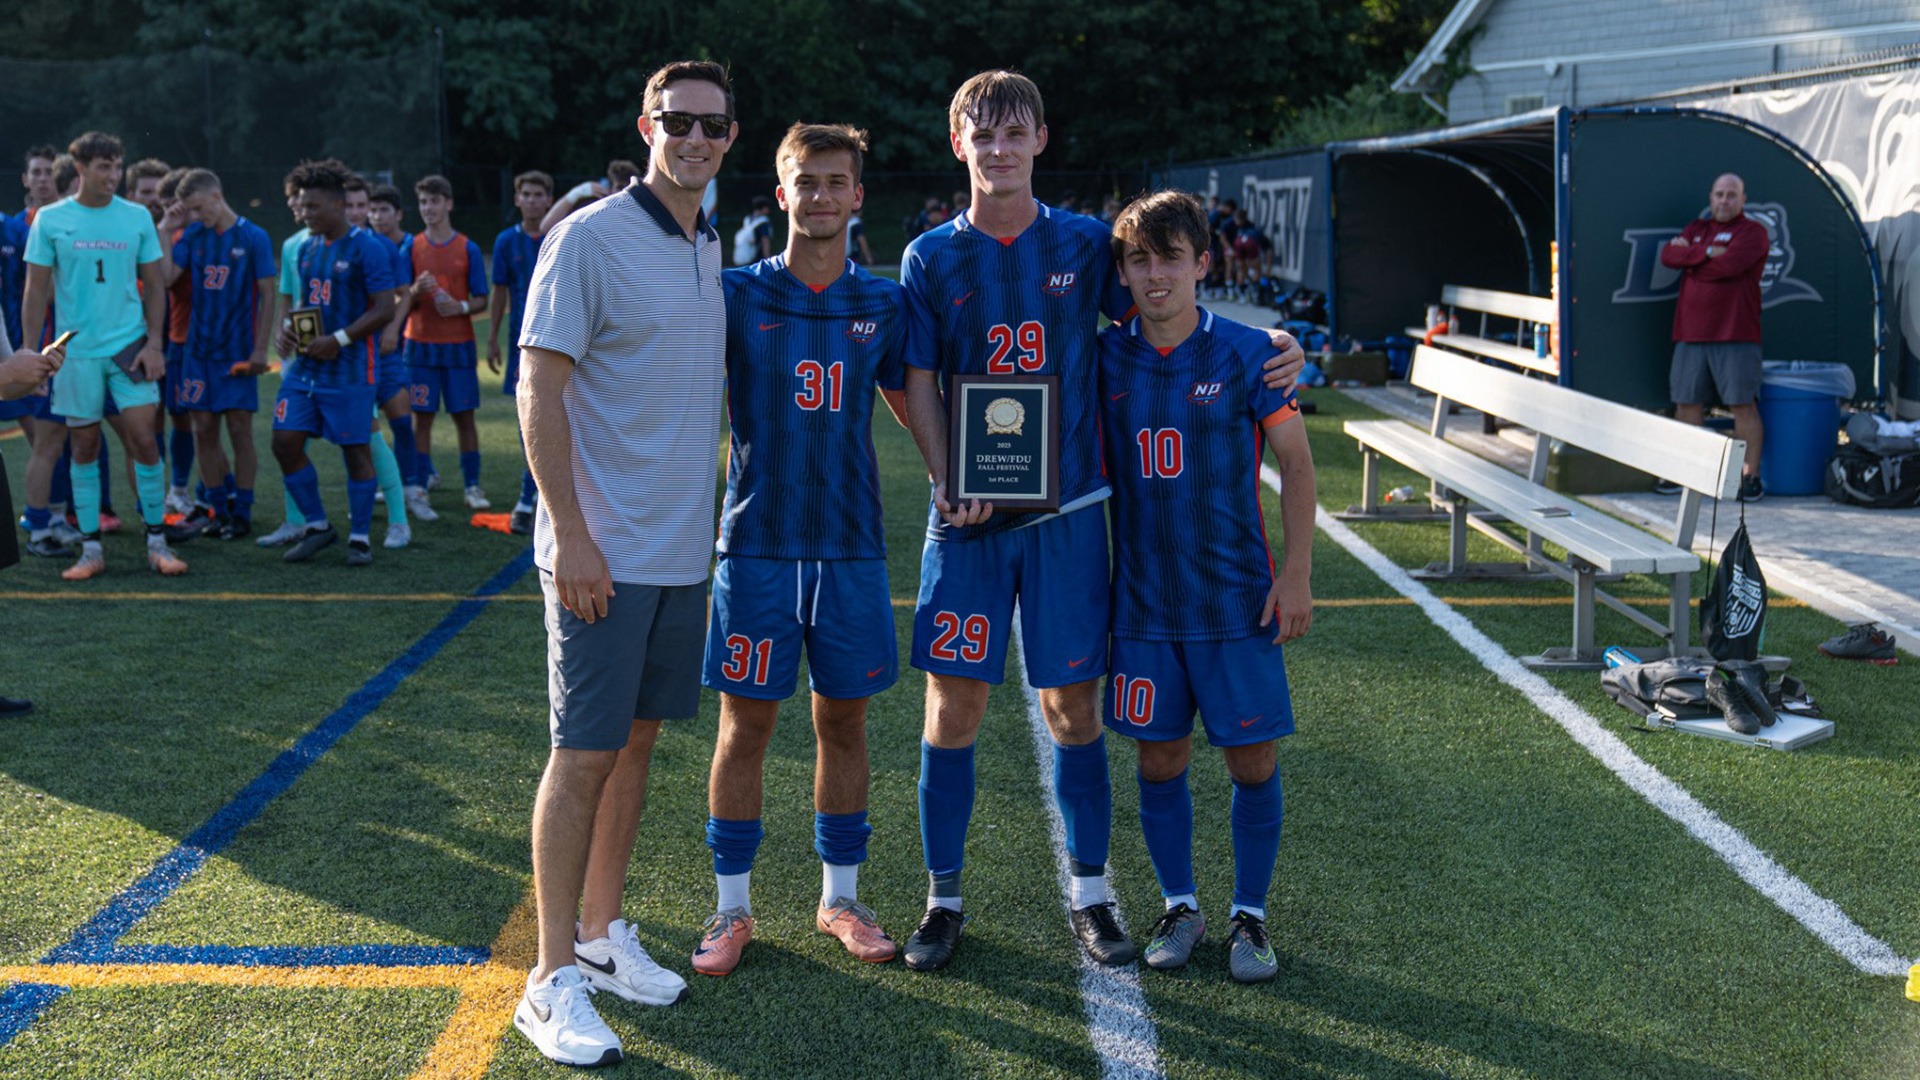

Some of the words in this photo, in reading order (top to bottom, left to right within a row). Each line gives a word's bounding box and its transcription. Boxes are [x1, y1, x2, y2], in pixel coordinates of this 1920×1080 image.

[95, 258, 106, 284] 1
[203, 265, 230, 291] 27
[1049, 272, 1076, 288] NP
[309, 278, 332, 305] 24
[852, 321, 877, 335] NP
[986, 320, 1047, 375] 29
[794, 359, 844, 412] 31
[1194, 382, 1222, 396] NP
[976, 454, 1032, 464] DREW/FDU
[1136, 427, 1184, 479] 10
[930, 609, 991, 663] 29
[722, 633, 773, 686] 31
[1114, 673, 1157, 727] 10
